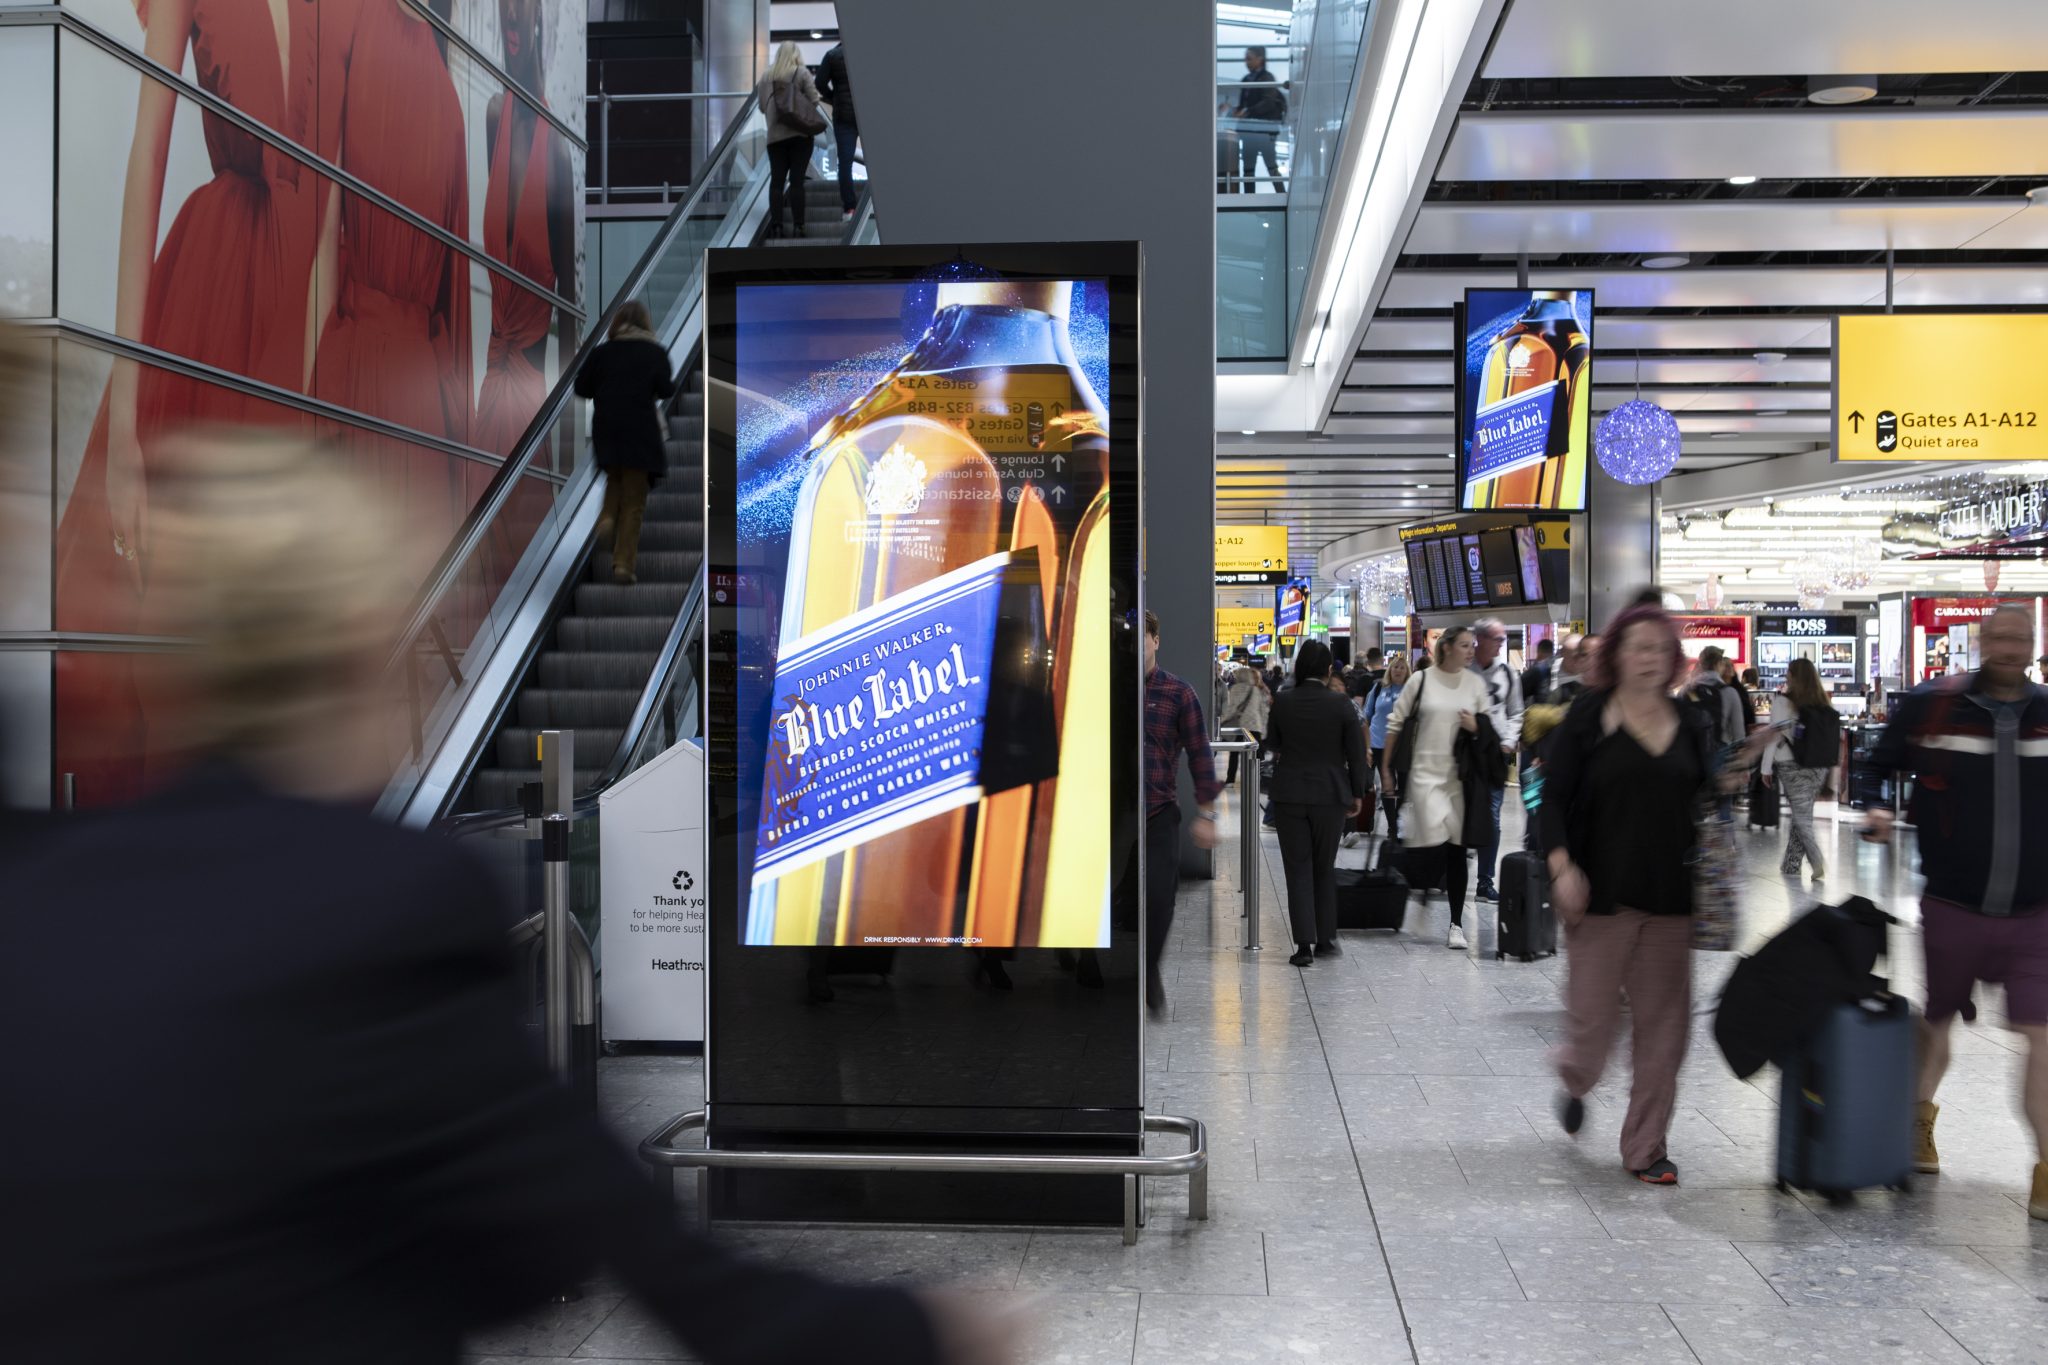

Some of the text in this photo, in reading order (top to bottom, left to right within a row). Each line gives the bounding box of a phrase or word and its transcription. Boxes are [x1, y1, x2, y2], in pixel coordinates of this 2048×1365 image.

[1901, 412, 2038, 428] Gates A1-A12
[1476, 425, 1507, 449] Blue
[1901, 436, 1979, 449] Quiet area
[1981, 491, 2041, 533] LAUDER
[1215, 537, 1244, 545] 1-A12
[1215, 574, 1237, 583] ounge
[1934, 607, 1980, 616] CAROLINA
[1683, 621, 1721, 635] Cartier
[1787, 618, 1827, 631] BOSS
[796, 652, 872, 700] JOHNNIE
[776, 694, 866, 765] Blue
[800, 700, 967, 778] BLENDED SCOTCH WHISKY
[824, 762, 863, 785] BLENDED
[865, 754, 883, 767] AND
[886, 737, 925, 759] BOTTLED
[942, 717, 978, 738] SCOTLA
[876, 764, 894, 777] AND
[923, 738, 961, 759] LIMITED
[768, 815, 810, 841] BLEND
[817, 804, 834, 820] OF
[841, 790, 870, 810] OUR
[877, 764, 933, 796] RAREST
[653, 895, 704, 909] Thank yo
[632, 908, 704, 922] for helping Hea
[629, 922, 703, 934] to be more sust
